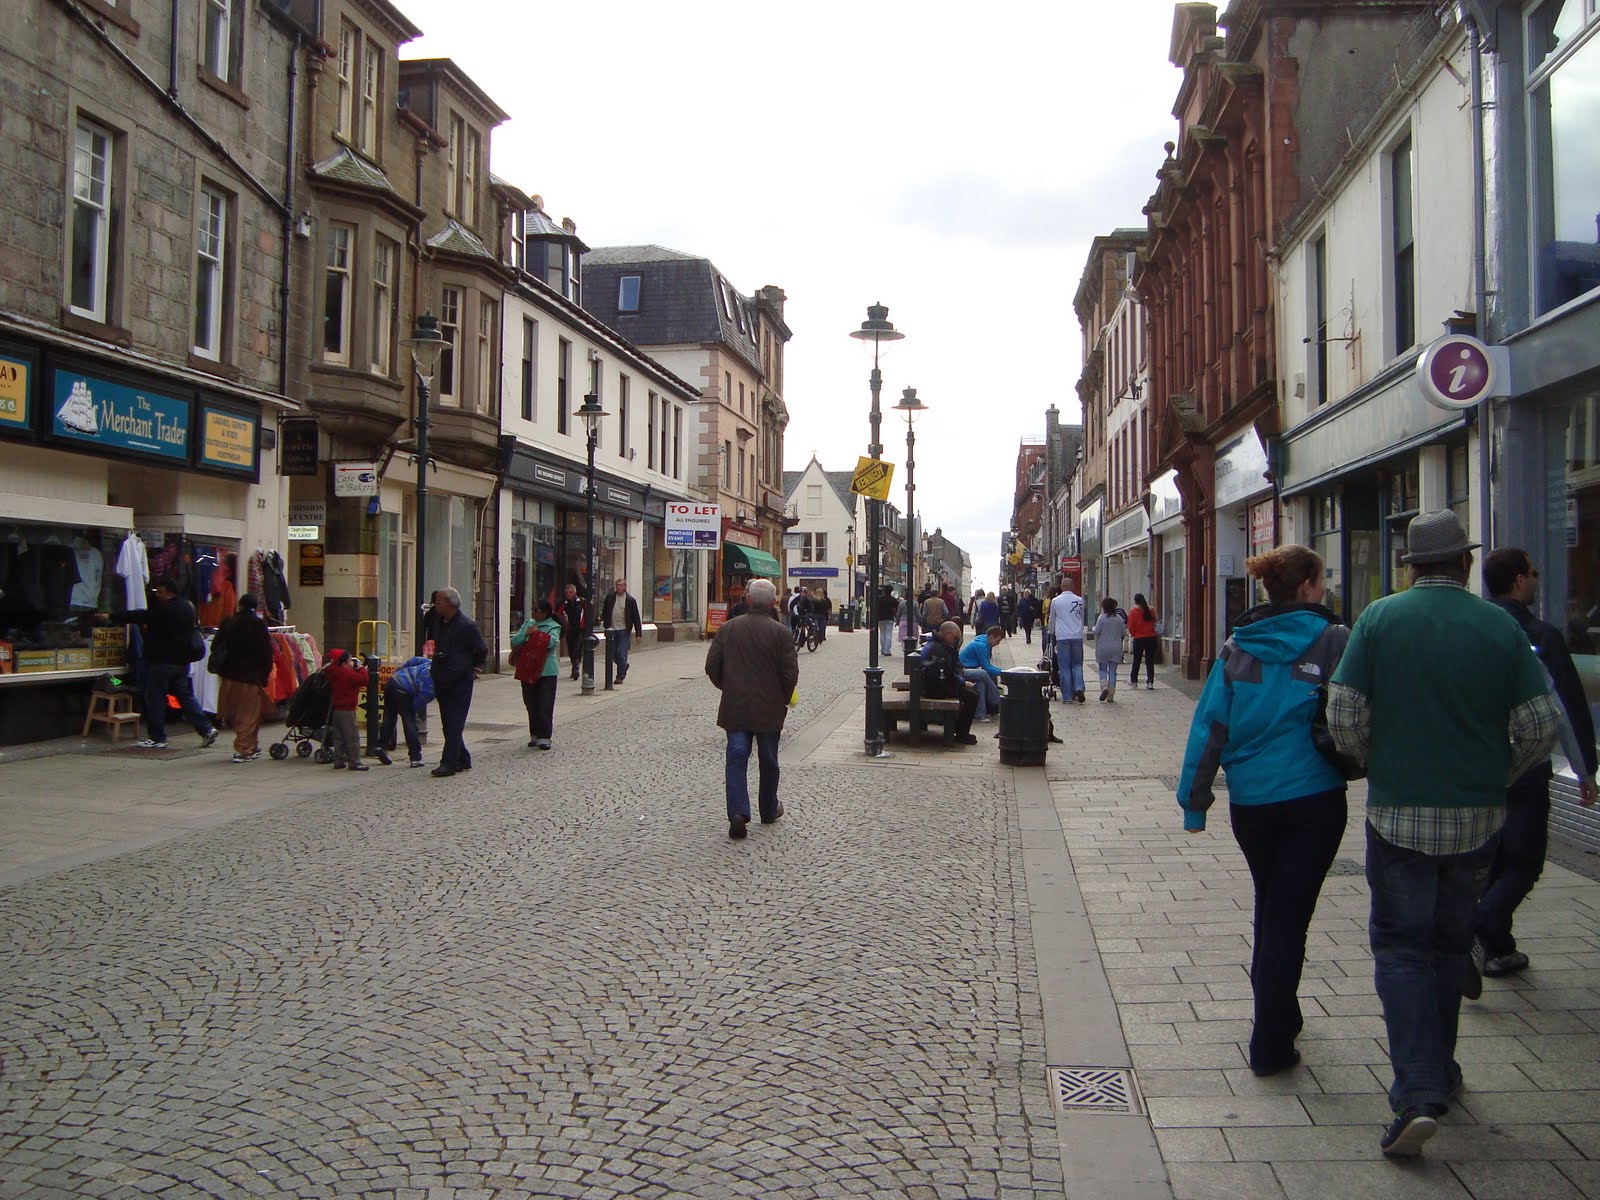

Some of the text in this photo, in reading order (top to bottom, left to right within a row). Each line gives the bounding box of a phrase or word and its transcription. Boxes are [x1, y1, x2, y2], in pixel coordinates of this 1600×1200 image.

[136, 395, 150, 411] The
[100, 400, 186, 445] Merchant Trader
[854, 463, 885, 491] KENNEDY
[346, 483, 375, 493] Bakery
[257, 499, 266, 508] 22
[669, 505, 718, 515] TO LET
